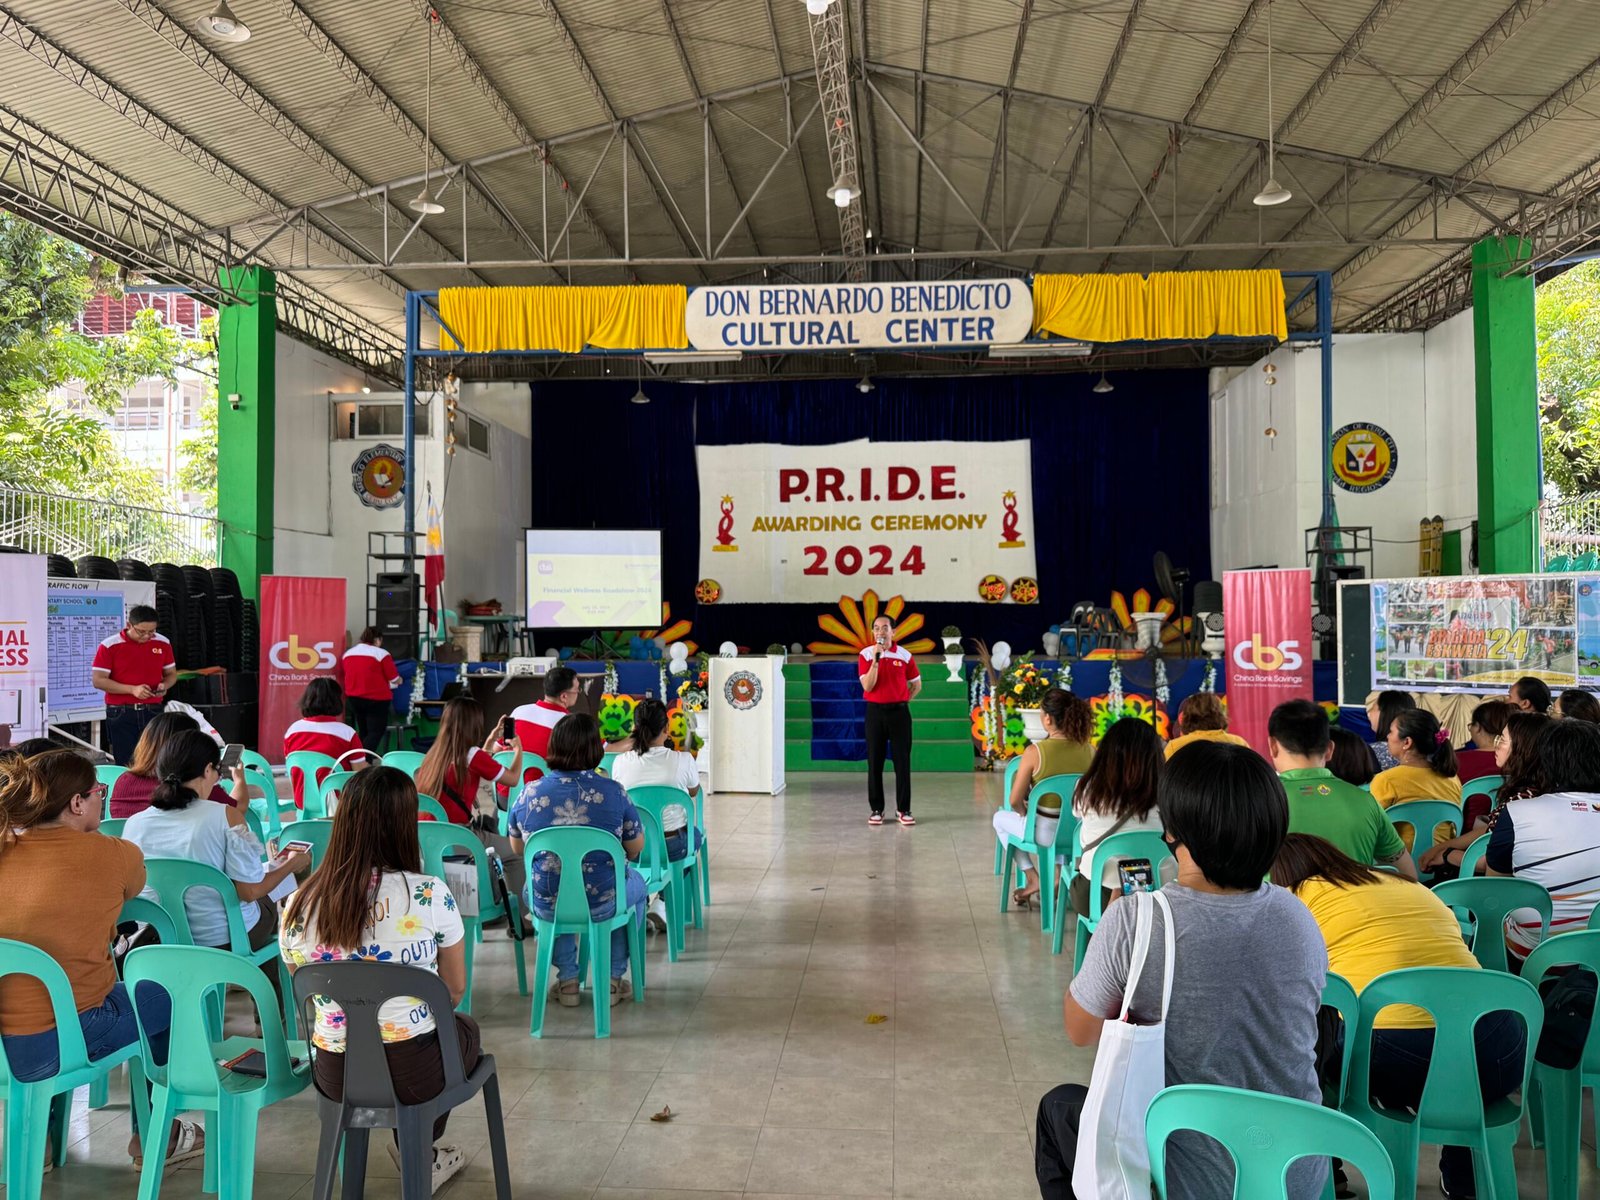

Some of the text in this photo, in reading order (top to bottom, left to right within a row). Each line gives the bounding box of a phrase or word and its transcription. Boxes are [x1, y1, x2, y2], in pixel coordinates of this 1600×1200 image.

[706, 283, 1012, 317] DON BERNARDO BENEDICTO
[721, 317, 995, 346] CULTURAL CENTER
[779, 465, 966, 503] P.R.I.D.E.
[752, 513, 987, 532] AWARDING CEREMONY
[803, 543, 926, 576] 2024
[48, 582, 70, 590] RAFFIC
[0, 629, 29, 646] IAL
[1428, 628, 1485, 644] BRIGADA
[0, 648, 29, 666] ESS
[269, 634, 337, 670] cbs
[1233, 632, 1304, 671] cbs
[1425, 643, 1488, 659] ESKWELA
[269, 674, 291, 682] China
[292, 673, 309, 681] Bank
[1233, 673, 1303, 684] China Bank Savings
